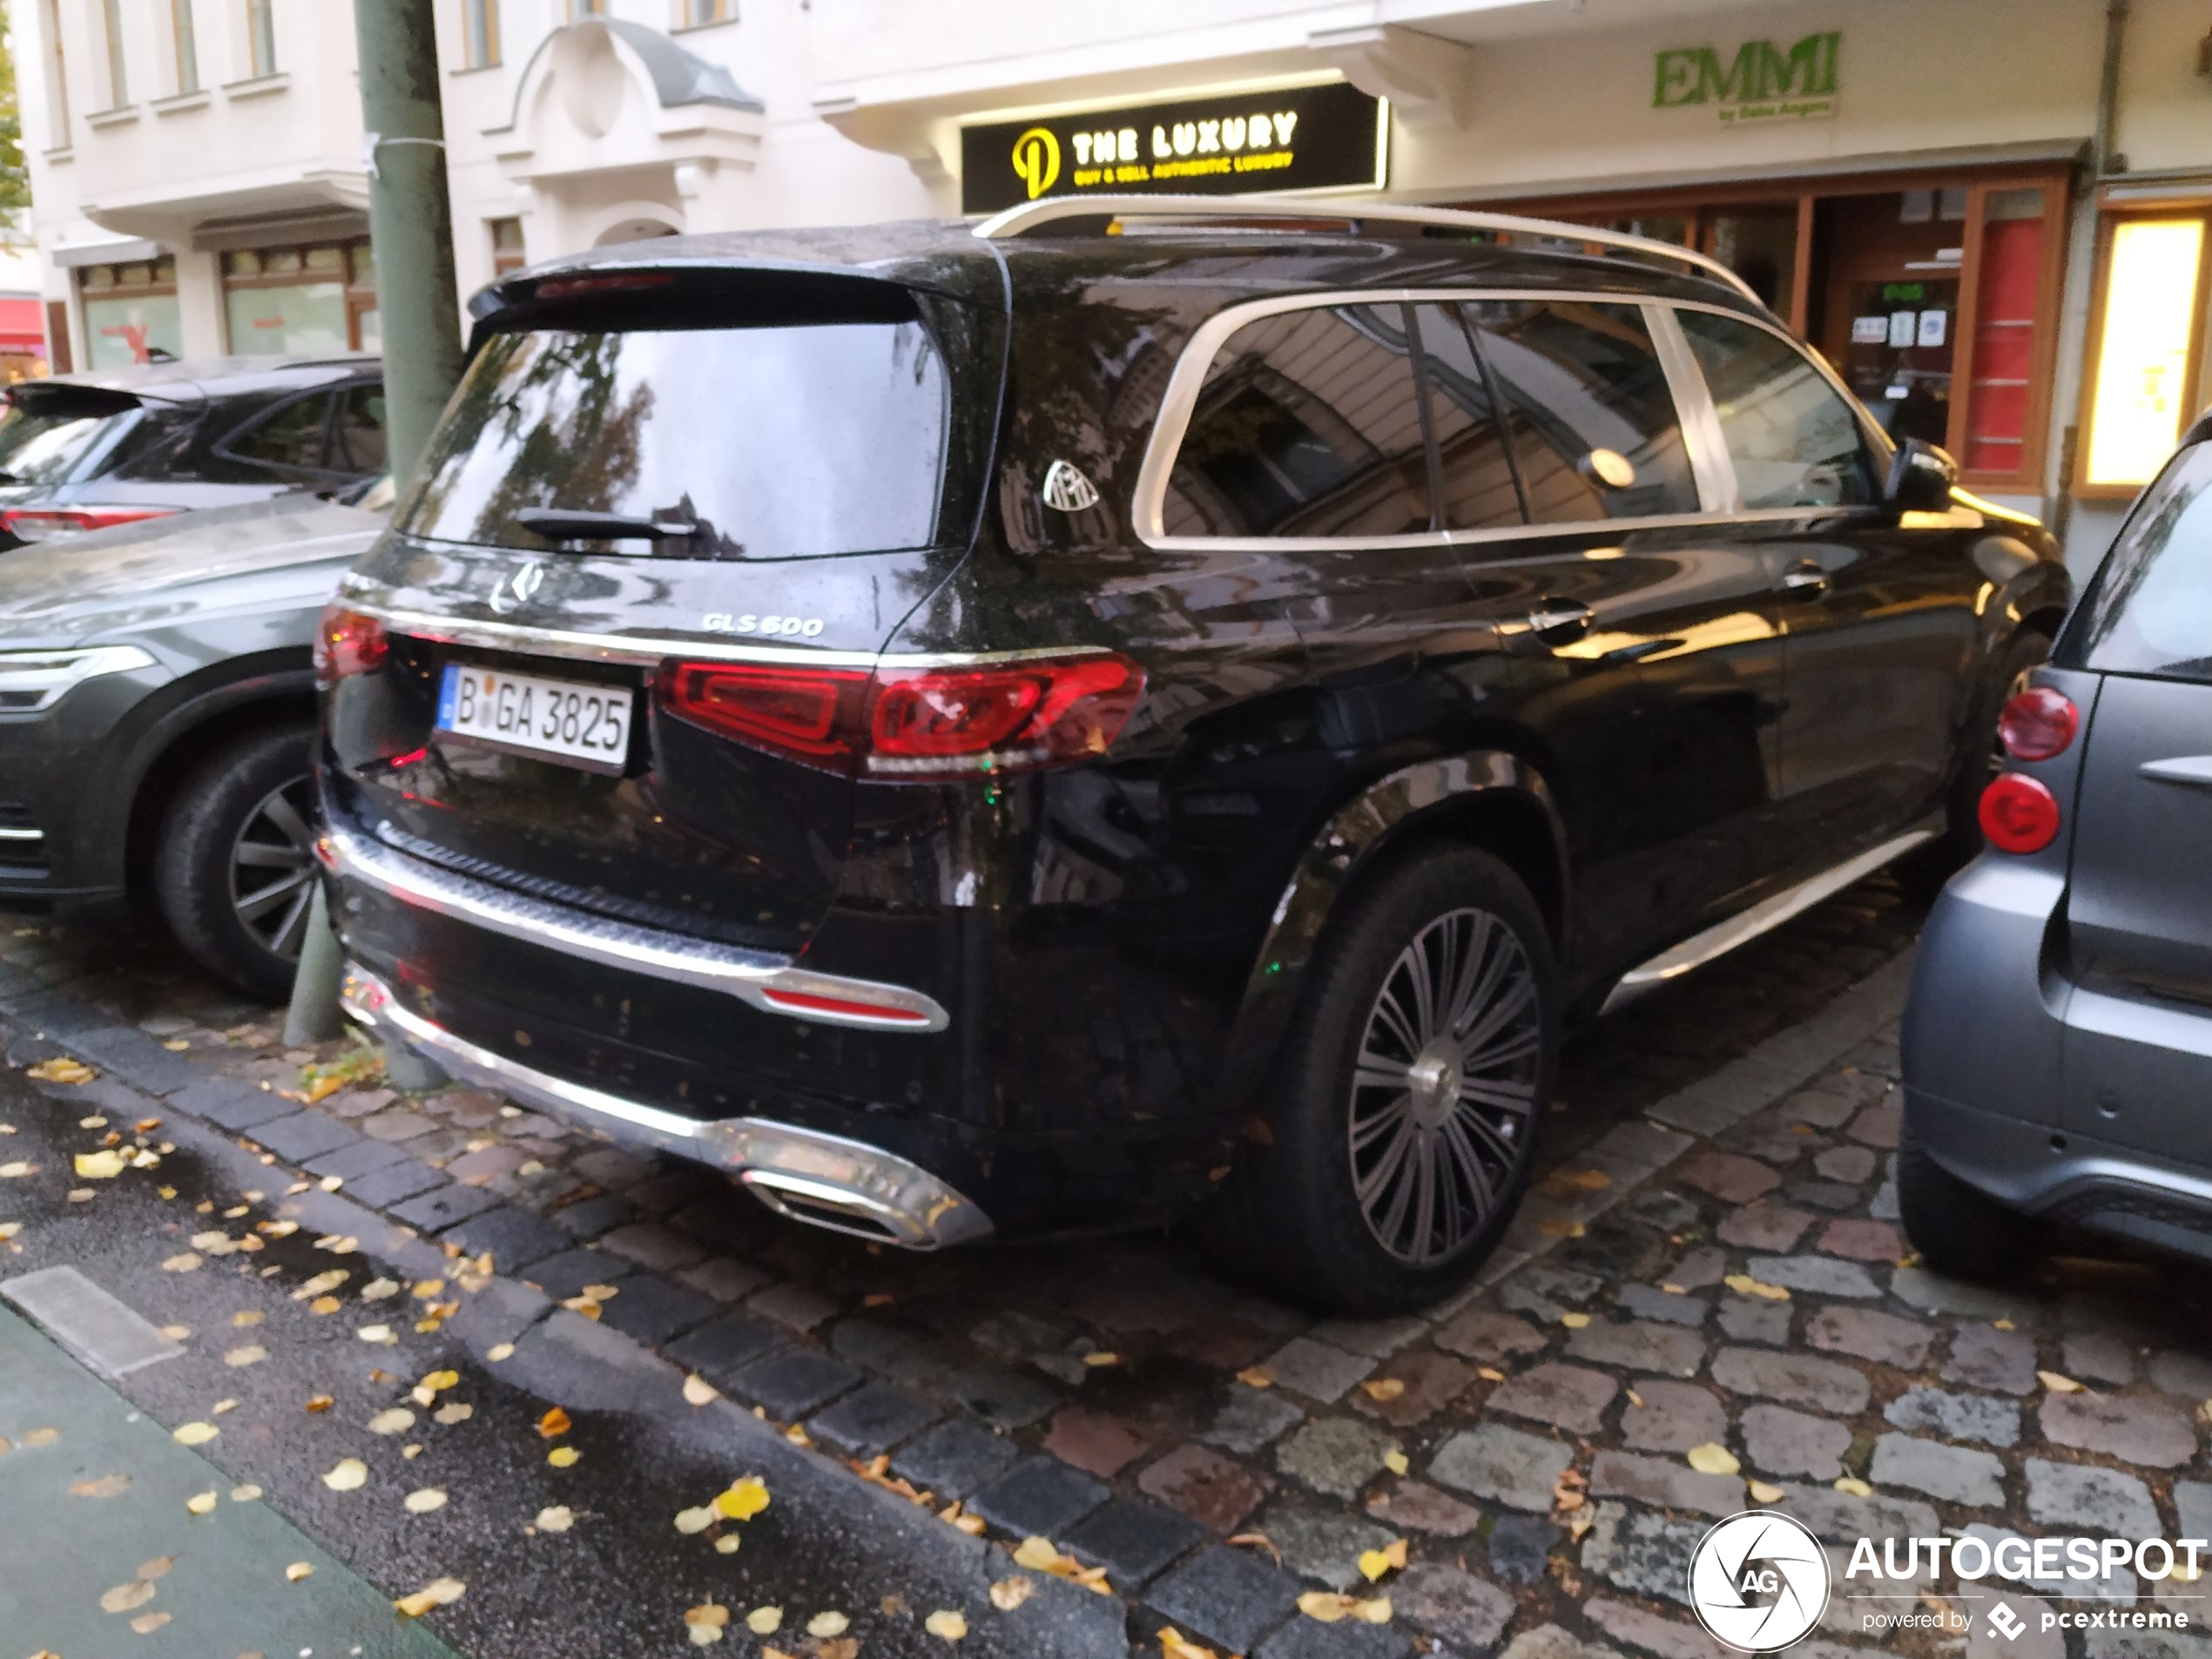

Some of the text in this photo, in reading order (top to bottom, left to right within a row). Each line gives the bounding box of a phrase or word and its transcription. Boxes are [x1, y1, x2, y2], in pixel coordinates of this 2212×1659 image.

[1652, 30, 1842, 107] EMMI
[1072, 111, 1298, 165] THE LUXURY
[702, 613, 824, 637] GLS 600
[458, 676, 625, 752] B GA 3825
